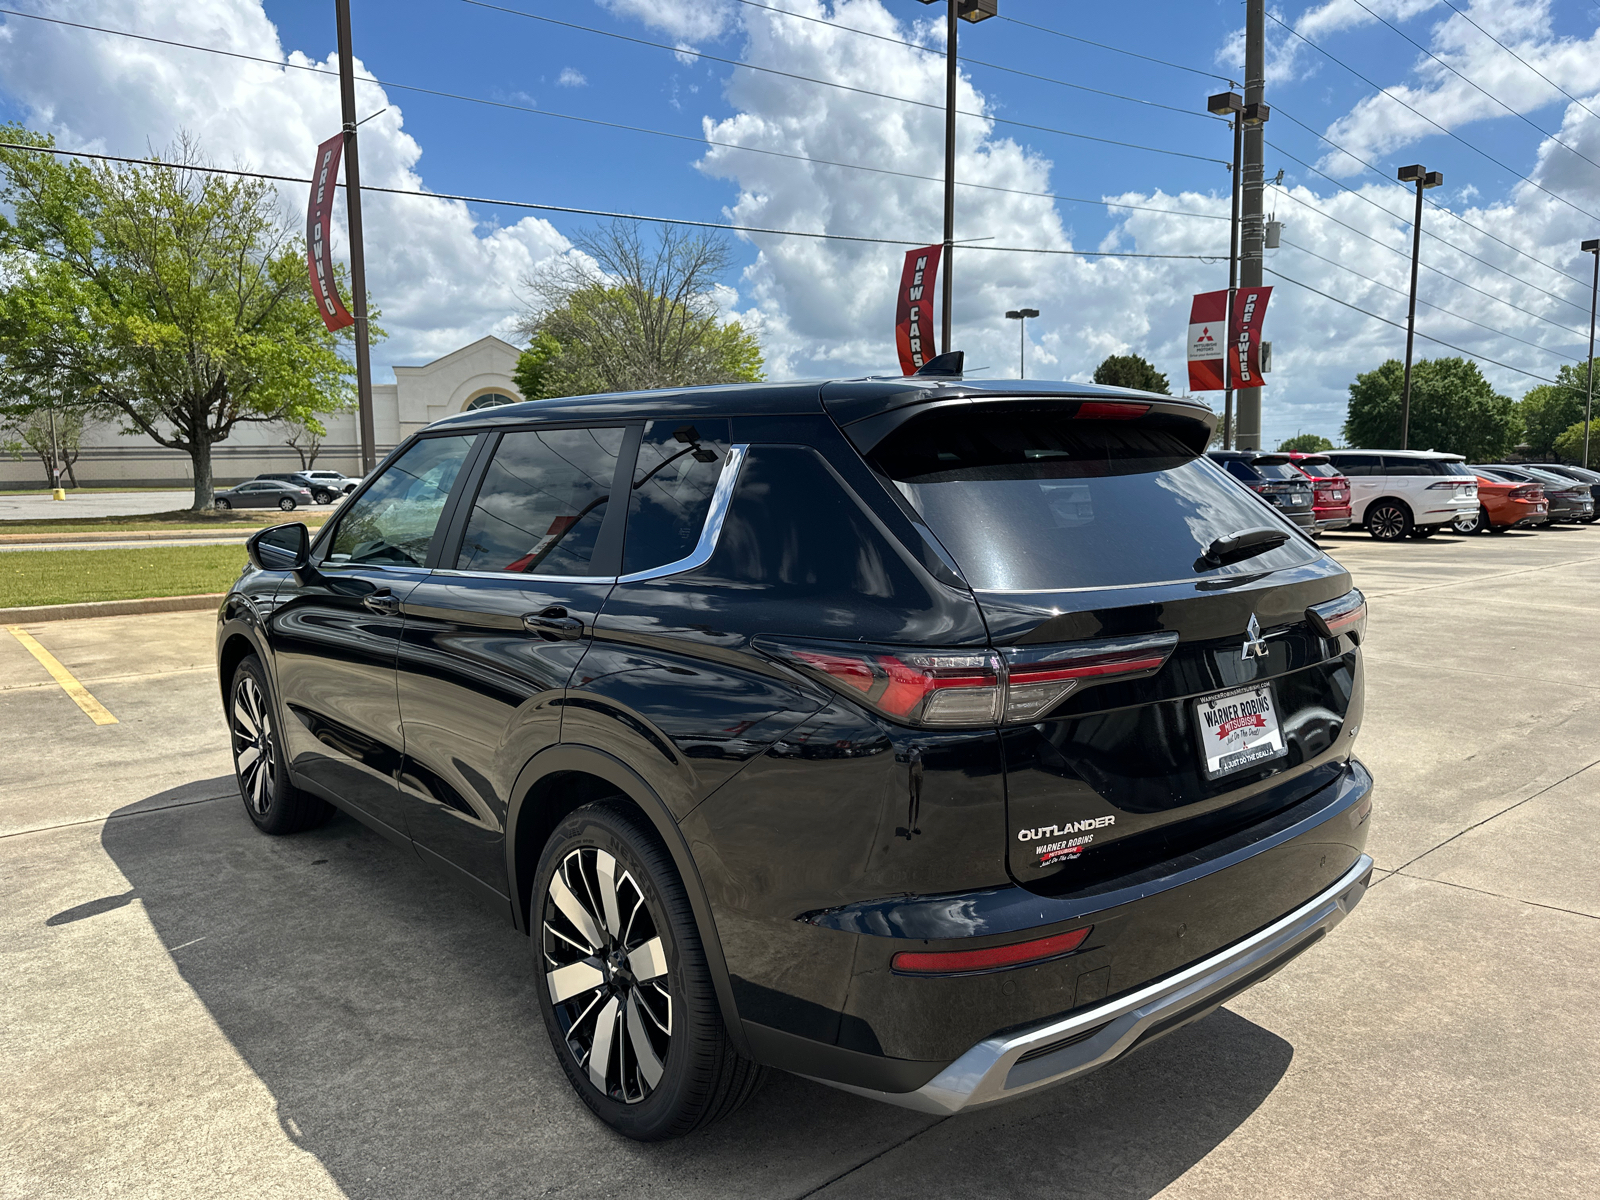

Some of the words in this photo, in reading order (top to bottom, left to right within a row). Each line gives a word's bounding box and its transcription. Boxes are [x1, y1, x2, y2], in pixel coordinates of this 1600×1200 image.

[909, 255, 928, 301] NEW
[909, 306, 924, 368] CARS
[1238, 294, 1258, 381] PRE-OWNED
[1204, 704, 1238, 728] WARNER
[1239, 696, 1269, 717] ROBINS
[1224, 715, 1257, 732] MITSUBISHI
[1226, 735, 1234, 745] Just
[1233, 731, 1240, 741] Do
[1240, 729, 1248, 737] The
[1228, 758, 1240, 768] JUST
[1239, 757, 1247, 765] DO
[1245, 753, 1256, 762] THE
[1018, 815, 1115, 842] OUTLANDER
[1036, 841, 1066, 855] WARNER
[1067, 834, 1094, 848] ROBINS
[1048, 846, 1078, 858] MITSUBISHI
[610, 836, 657, 904] NEXEN
[558, 1051, 602, 1113] ROADIAN
